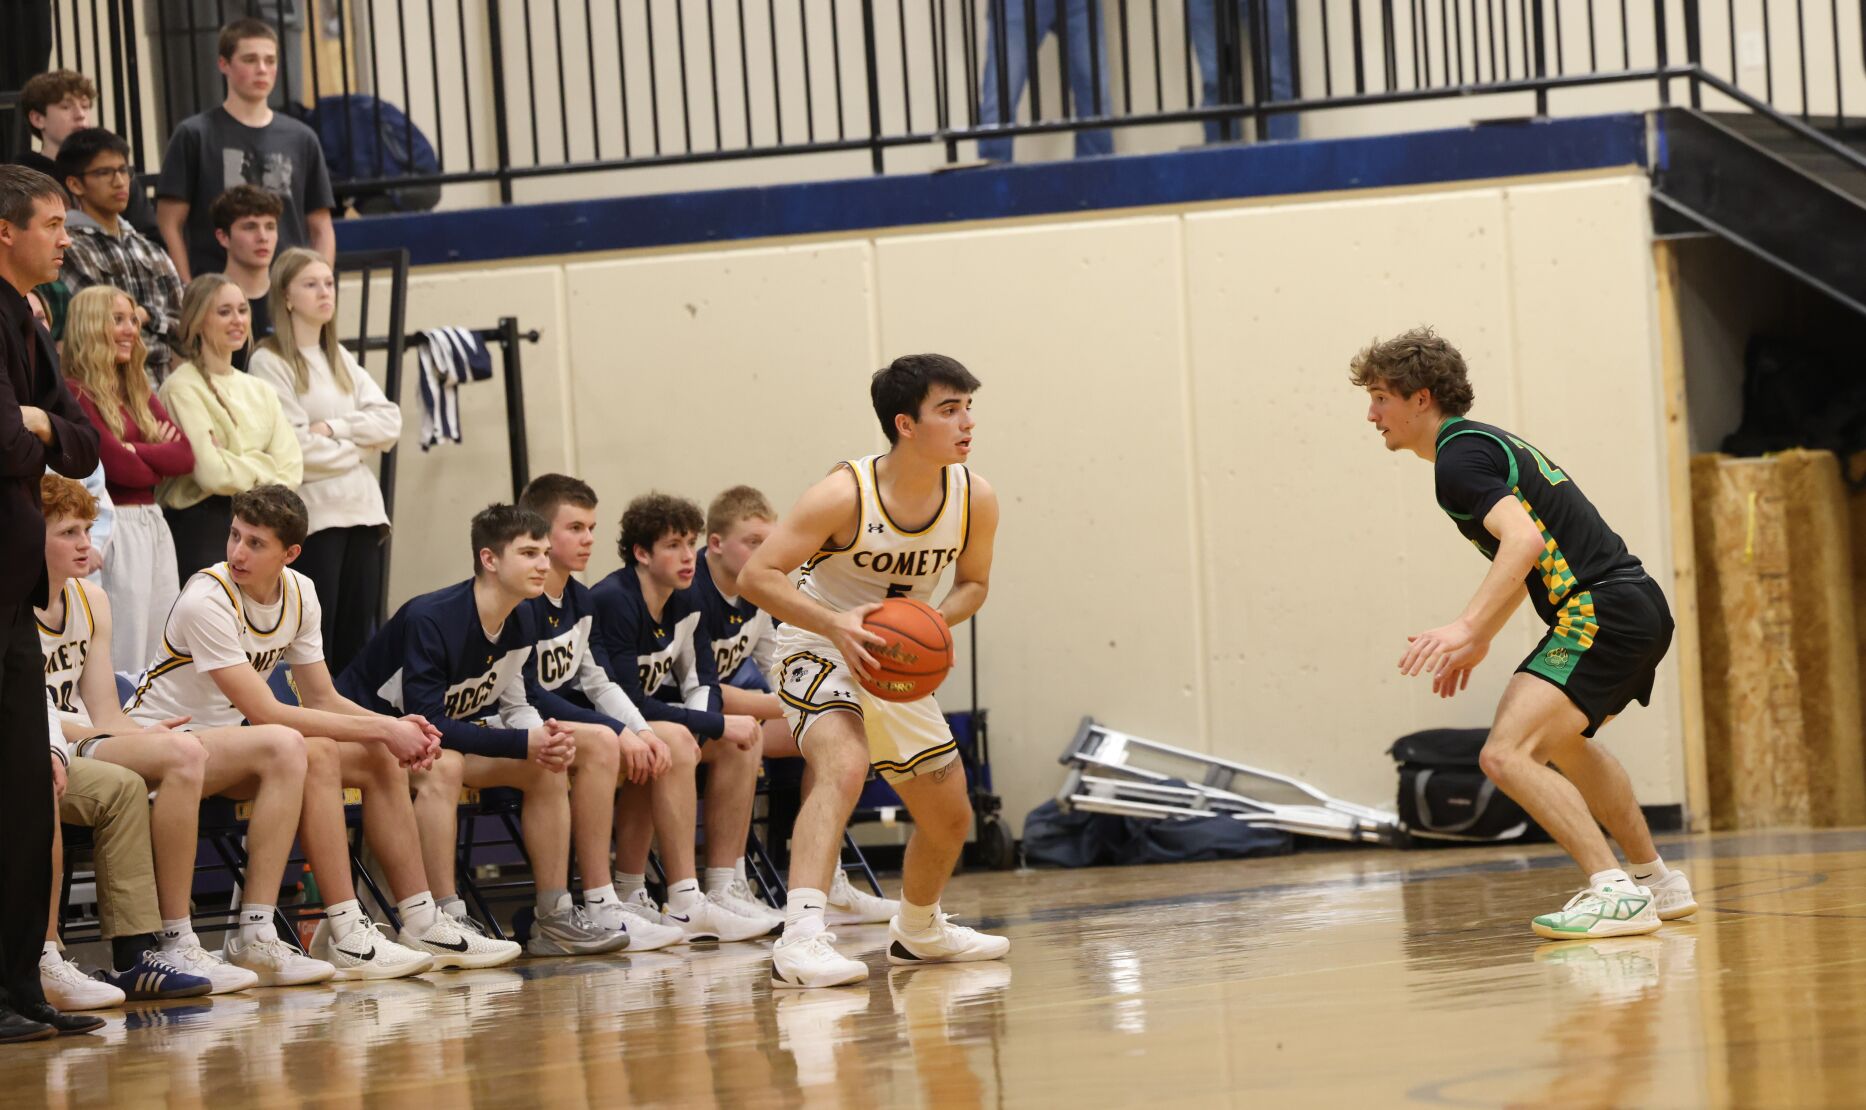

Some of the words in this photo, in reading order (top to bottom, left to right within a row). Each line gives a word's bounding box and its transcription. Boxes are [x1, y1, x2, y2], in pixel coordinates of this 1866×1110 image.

[853, 548, 957, 576] COMETS
[541, 640, 574, 683] CCS
[717, 635, 748, 674] CCS
